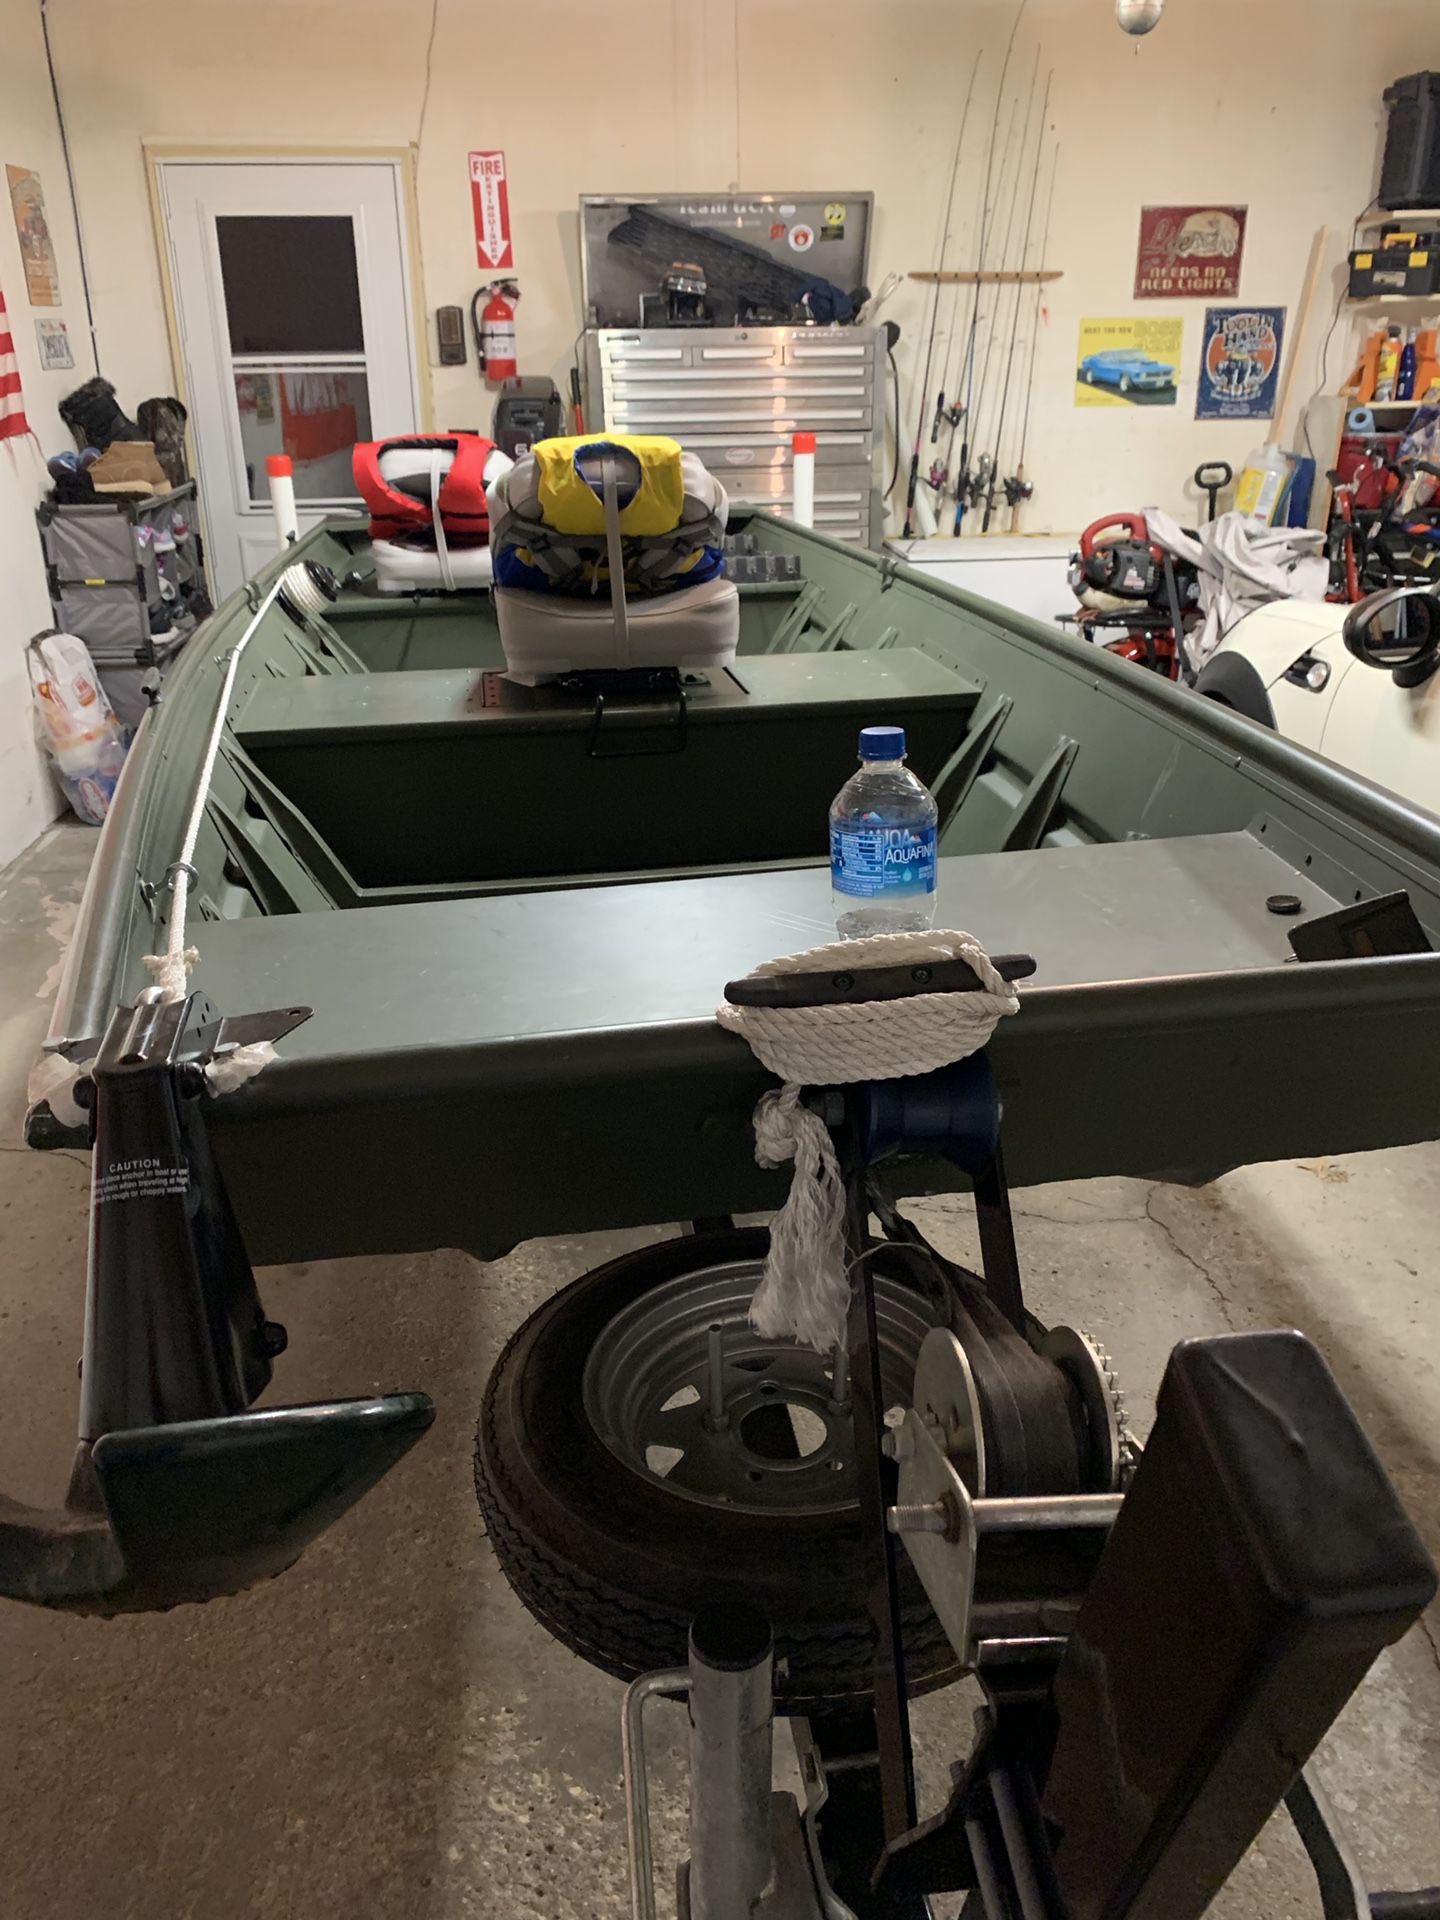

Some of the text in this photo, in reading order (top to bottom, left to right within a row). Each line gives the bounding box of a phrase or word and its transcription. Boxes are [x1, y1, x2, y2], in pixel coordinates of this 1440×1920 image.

[472, 160, 502, 175] FIRE
[485, 176, 499, 260] EXTINGUISHER
[1204, 265, 1226, 278] NO
[1178, 277, 1233, 290] LIGHTS
[109, 1158, 160, 1173] CAUTION
[121, 1171, 145, 1180] anchor
[119, 1180, 137, 1190] when
[140, 1188, 165, 1197] choppy
